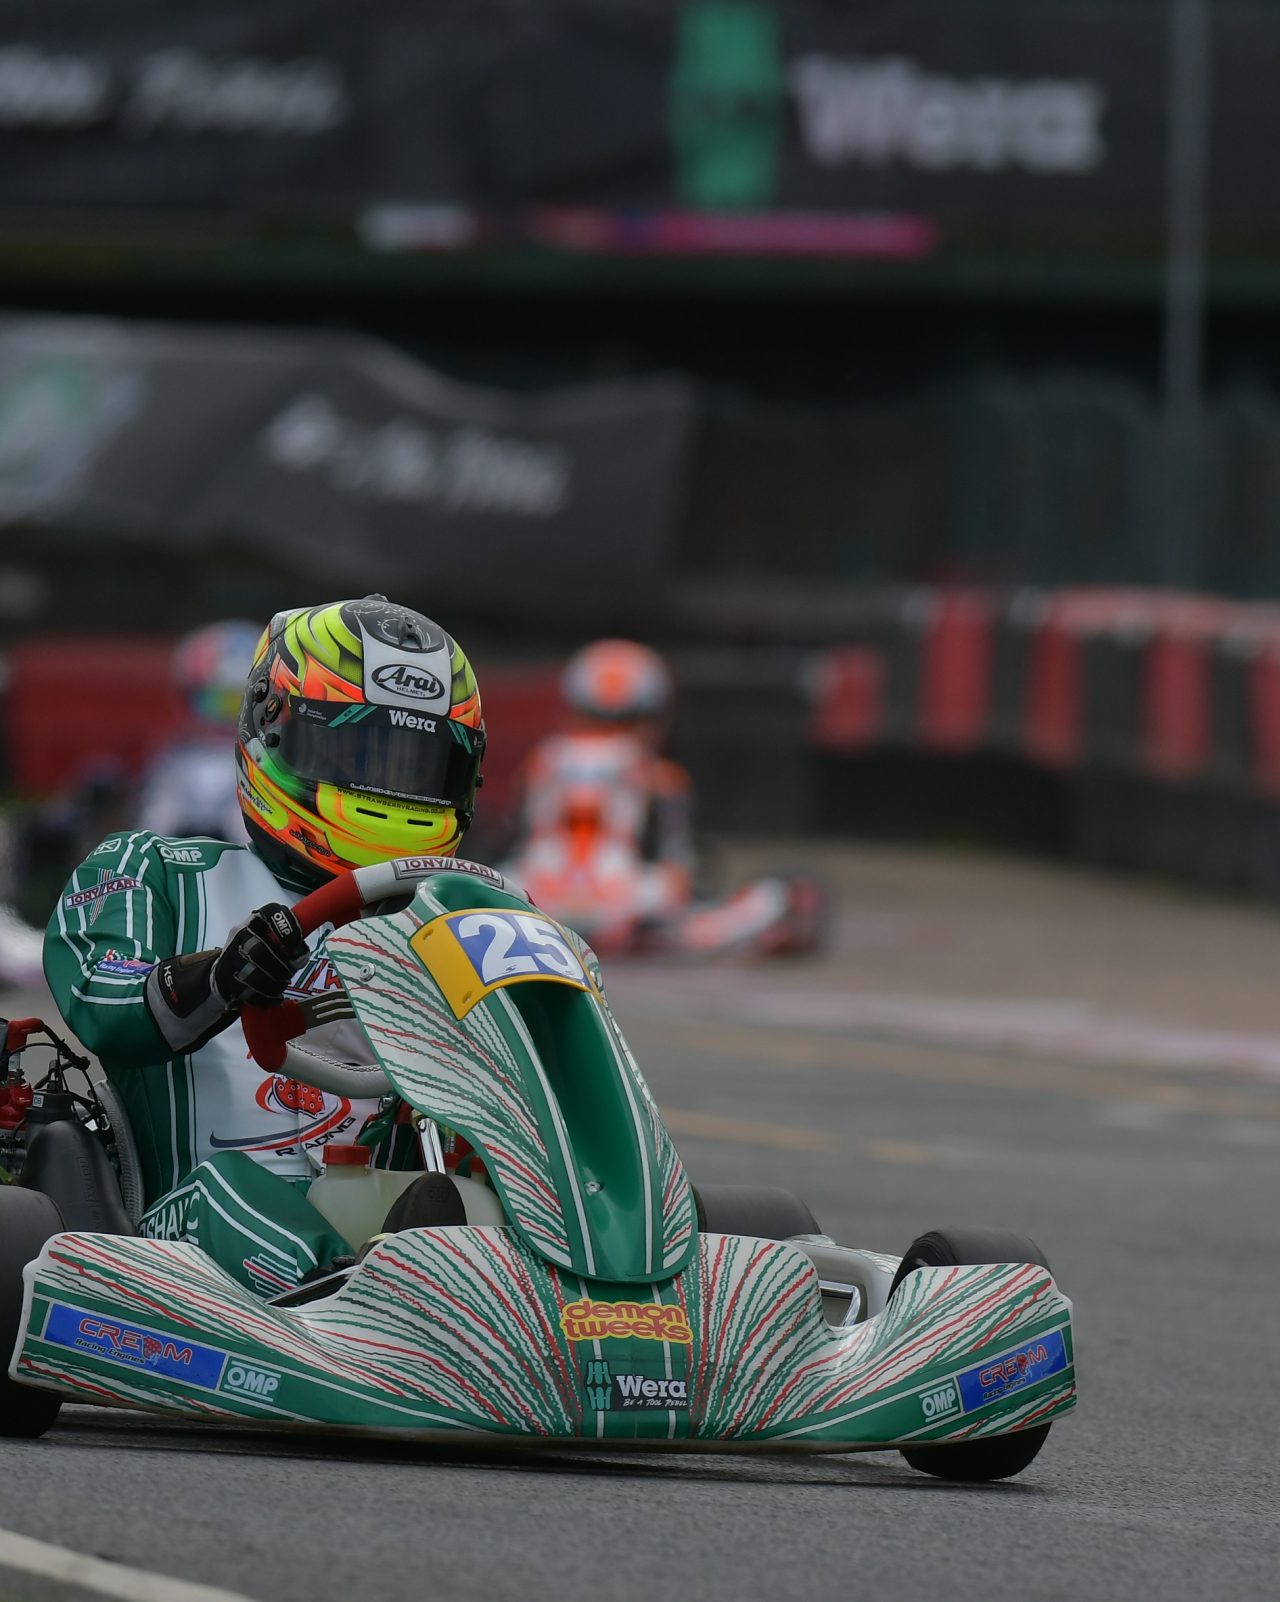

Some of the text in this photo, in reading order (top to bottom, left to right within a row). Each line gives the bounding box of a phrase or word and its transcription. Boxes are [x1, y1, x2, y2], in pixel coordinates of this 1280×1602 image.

[377, 666, 437, 693] Arai
[388, 709, 437, 733] Wera
[160, 846, 203, 862] OMP
[273, 912, 291, 936] OMP
[458, 914, 584, 984] 25
[565, 1300, 684, 1323] demon
[563, 1318, 691, 1341] tweeks
[74, 1337, 146, 1365] Racing Engines
[227, 1366, 279, 1396] OMP
[615, 1375, 688, 1398] Wera
[623, 1398, 636, 1407] BE
[645, 1398, 662, 1407] TOOL
[664, 1398, 688, 1408] REBEL
[921, 1387, 957, 1417] OMP
